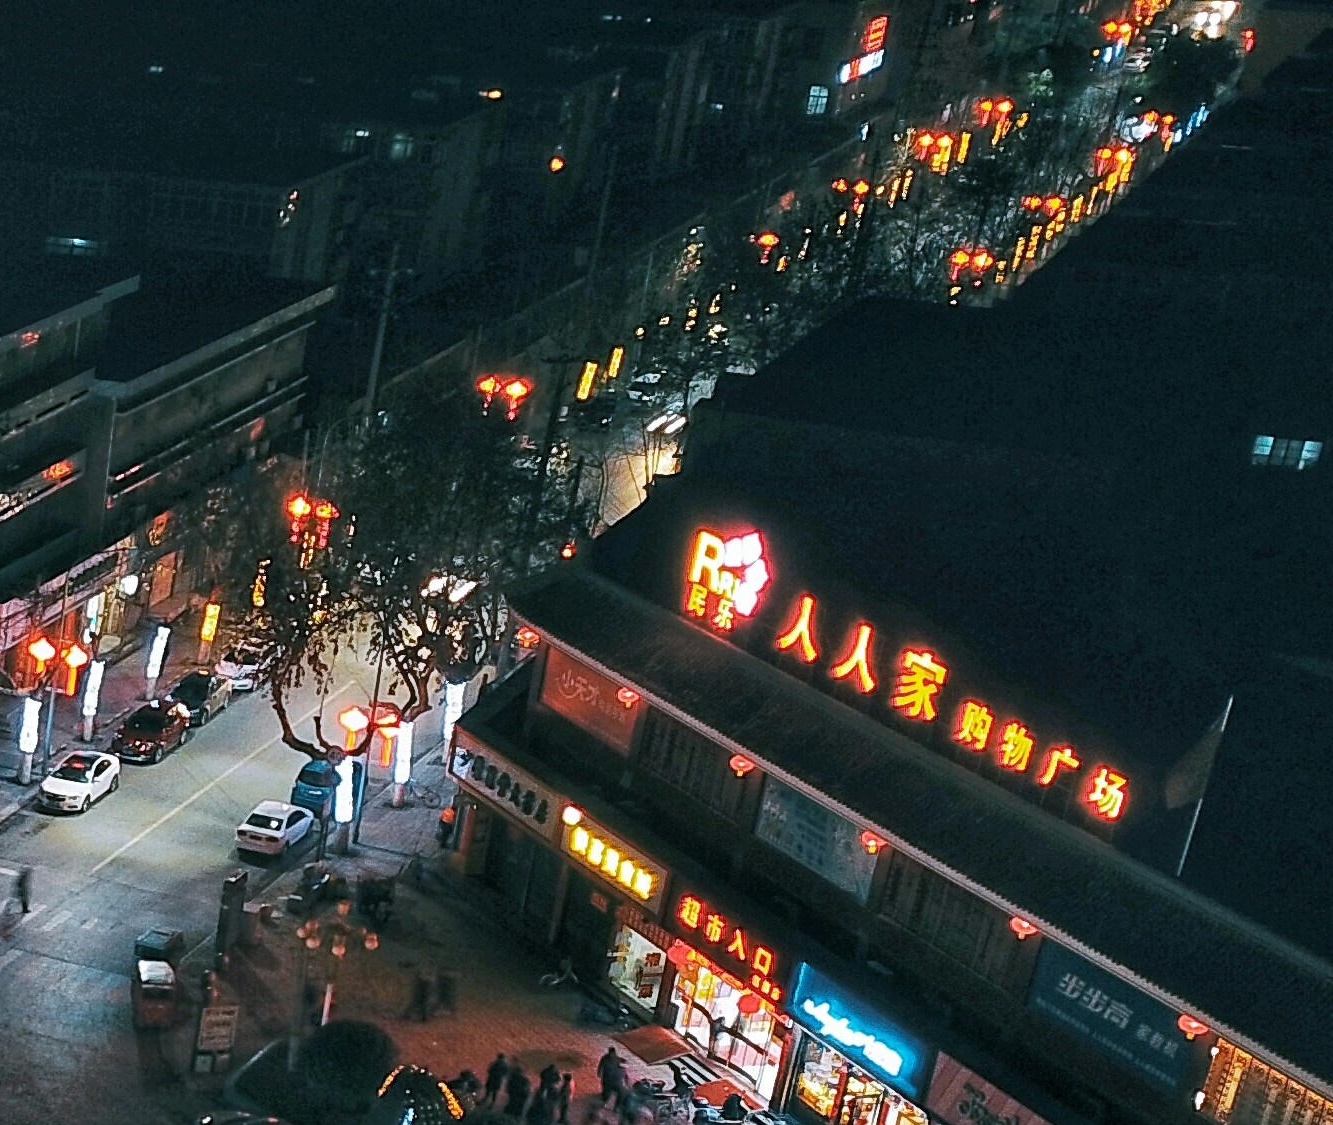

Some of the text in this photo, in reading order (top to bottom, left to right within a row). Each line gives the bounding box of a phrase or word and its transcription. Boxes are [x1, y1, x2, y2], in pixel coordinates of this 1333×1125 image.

[687, 583, 735, 631] 民乐
[680, 896, 774, 977] 超市入口
[1055, 973, 1135, 1030] 步步高
